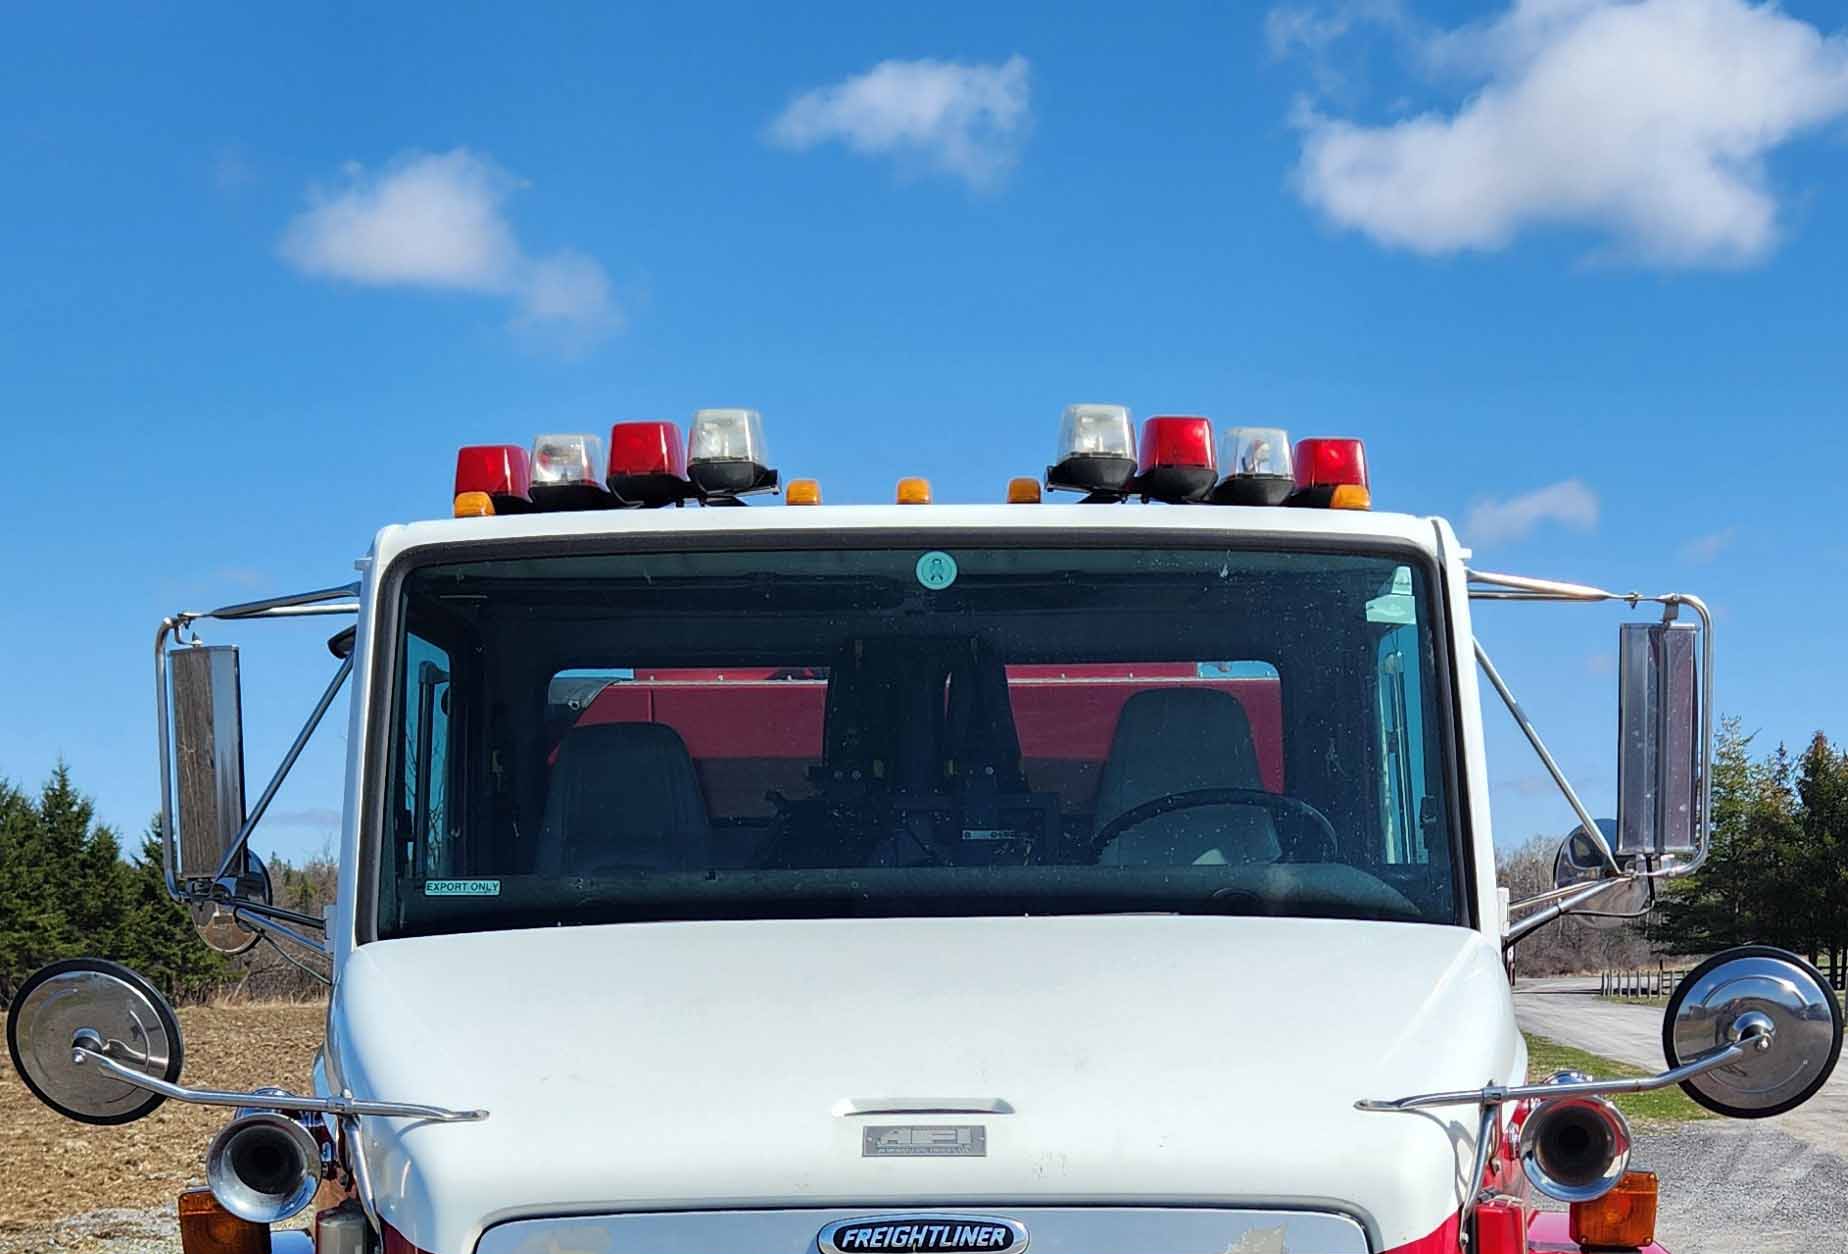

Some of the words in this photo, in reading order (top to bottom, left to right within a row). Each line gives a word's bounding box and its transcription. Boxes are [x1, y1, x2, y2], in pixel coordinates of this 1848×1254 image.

[426, 882, 467, 892] EXPORT
[470, 882, 499, 892] ONLY
[841, 1225, 1006, 1248] FREIGHTLINER
